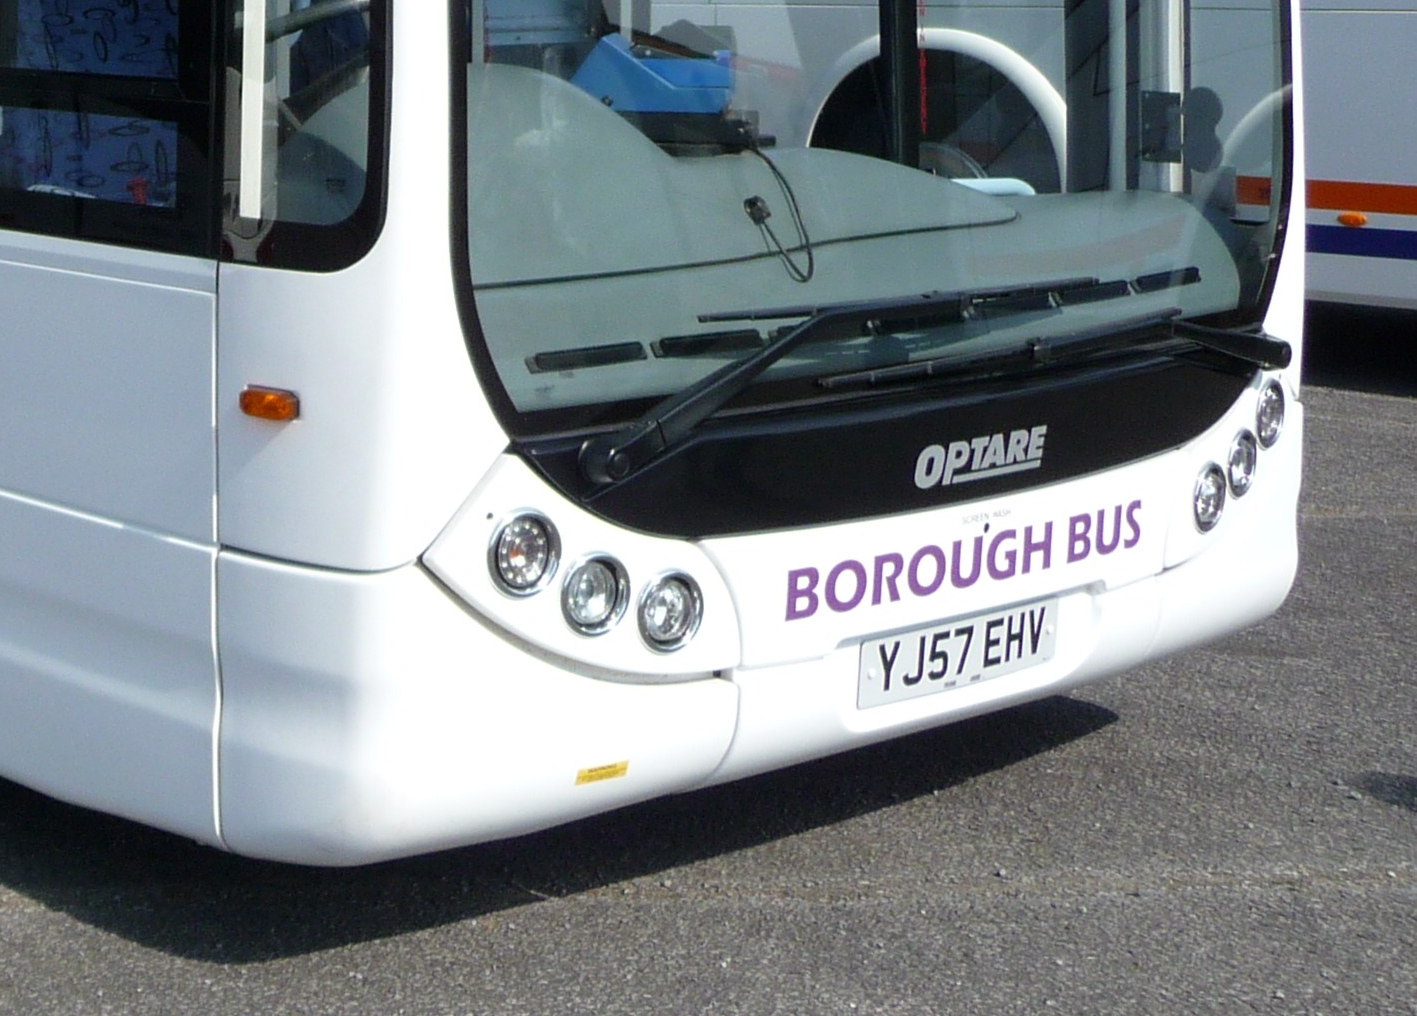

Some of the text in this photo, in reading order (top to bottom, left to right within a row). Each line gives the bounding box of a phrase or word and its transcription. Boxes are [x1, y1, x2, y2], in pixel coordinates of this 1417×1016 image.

[914, 424, 1048, 489] OPTARE
[785, 499, 1142, 622] BOROUGH BUS
[879, 606, 1047, 692] YJ57 EHV
